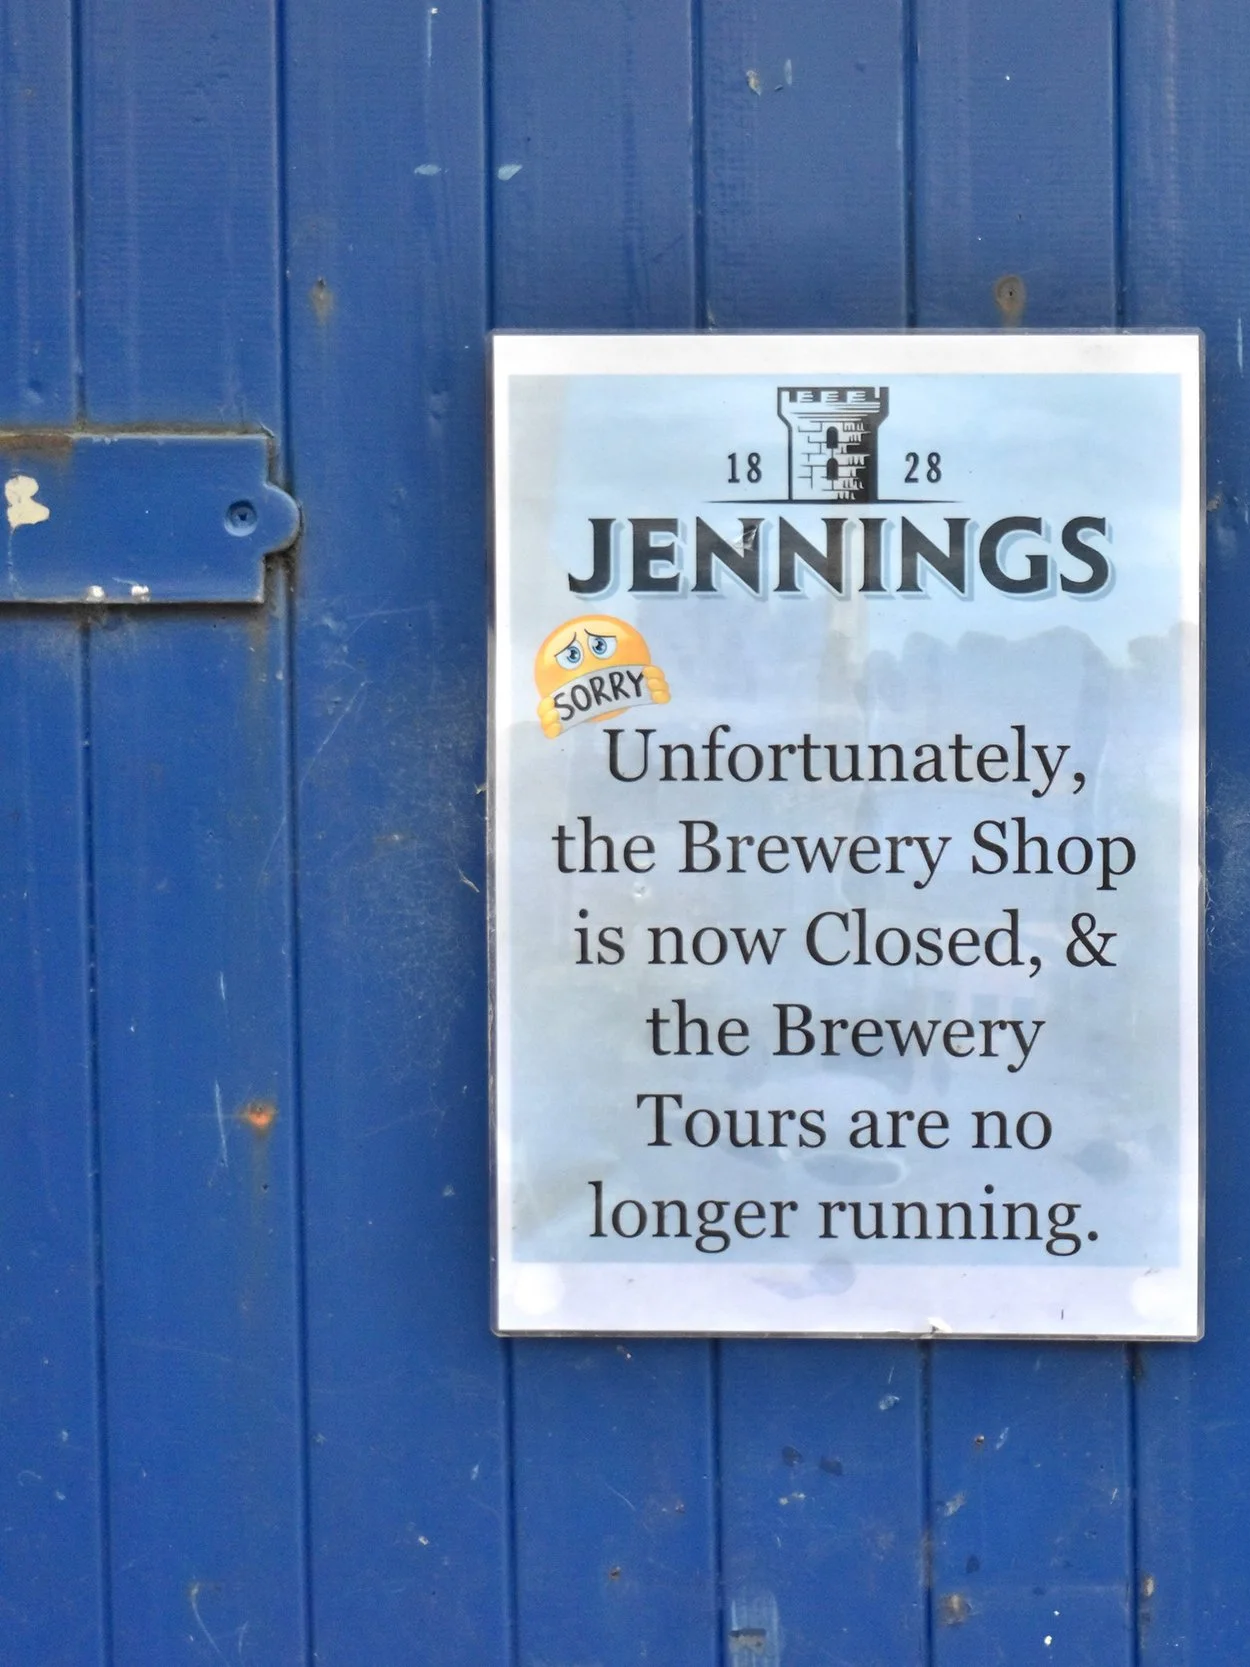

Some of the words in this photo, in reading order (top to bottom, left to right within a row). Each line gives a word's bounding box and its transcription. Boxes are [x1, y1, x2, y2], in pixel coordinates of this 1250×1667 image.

[727, 452, 762, 483] 18
[904, 452, 941, 483] 28
[567, 515, 1112, 597] JENNINGS
[554, 669, 645, 721] SORRY
[603, 724, 1086, 799] Unfortunately,
[551, 815, 655, 874] the
[678, 820, 952, 890] Brewery
[971, 816, 1137, 891] Shop
[574, 908, 626, 965] is
[647, 925, 787, 966] now
[805, 907, 1043, 978] Closed,
[1065, 912, 1118, 968] &
[645, 998, 750, 1057] the
[772, 1003, 1046, 1074] Brewery
[636, 1093, 827, 1149] Tours
[848, 1110, 949, 1149] are
[971, 1110, 1052, 1150] no
[587, 1180, 798, 1254] longer
[818, 1184, 1099, 1257] running.
